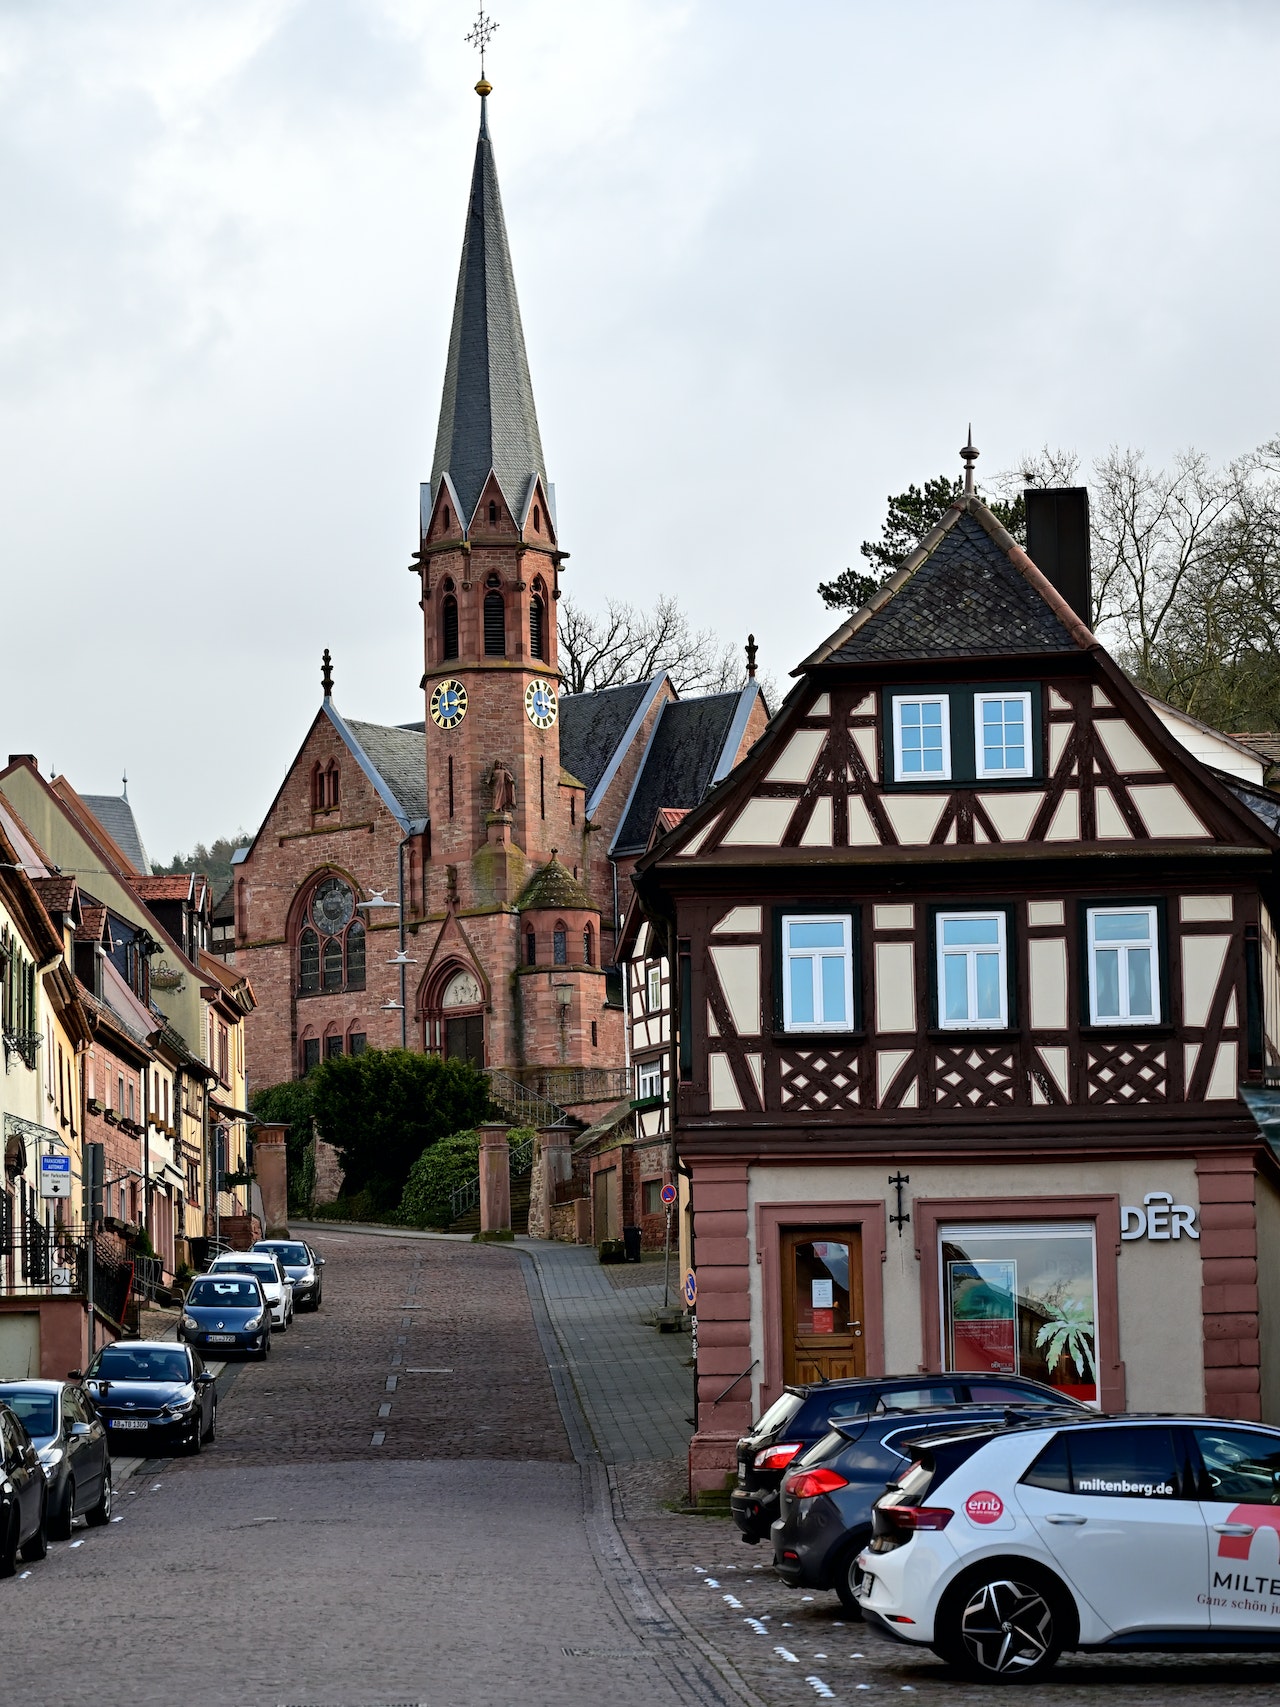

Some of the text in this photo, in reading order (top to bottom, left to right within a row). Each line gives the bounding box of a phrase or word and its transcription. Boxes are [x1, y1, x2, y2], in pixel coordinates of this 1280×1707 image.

[1080, 1479, 1174, 1496] miltenberg.de
[968, 1498, 1001, 1511] emb
[1213, 1571, 1280, 1596] MILTE
[1197, 1593, 1228, 1607] Ganz
[1231, 1598, 1267, 1612] schön
